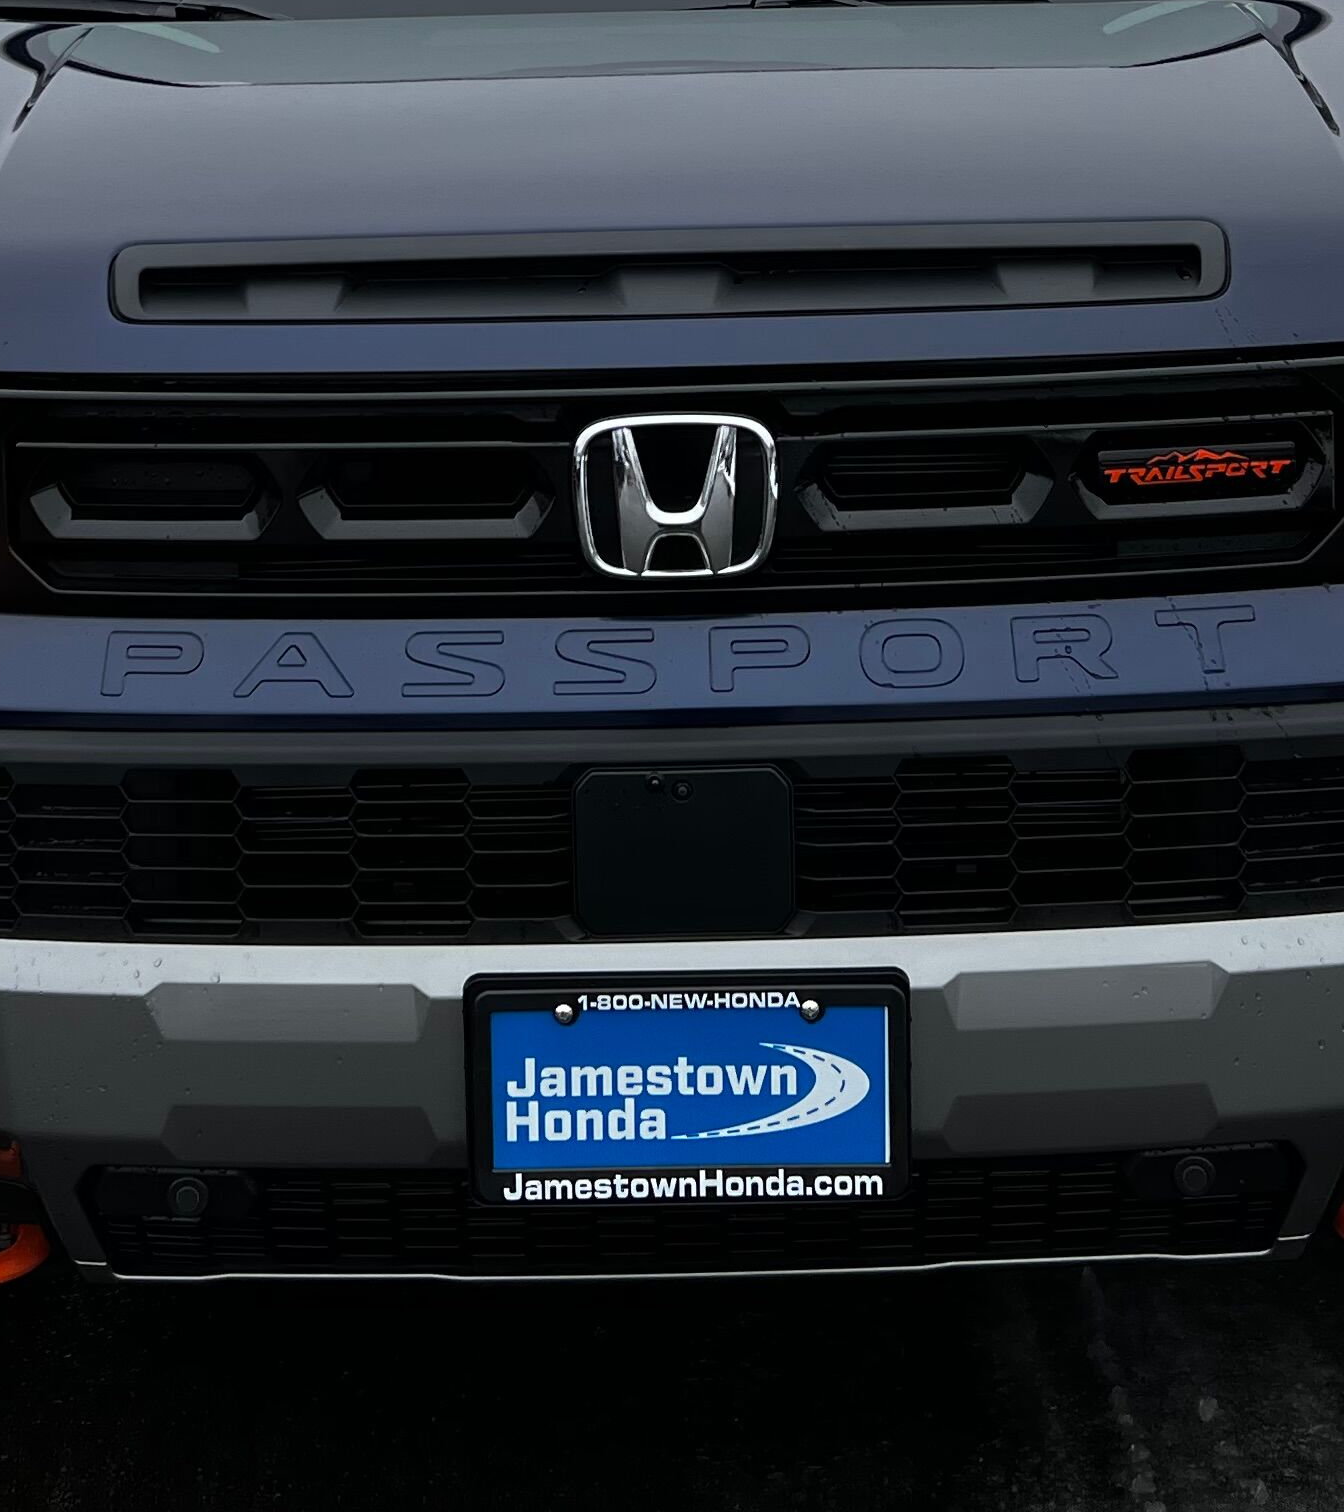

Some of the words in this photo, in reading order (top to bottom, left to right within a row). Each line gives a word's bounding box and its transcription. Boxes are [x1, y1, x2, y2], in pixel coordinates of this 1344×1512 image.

[1104, 460, 1293, 485] TRAILSPORT
[101, 604, 1255, 697] PASSPORT
[577, 991, 801, 1011] 1-800-NEW-HONDA
[506, 1056, 798, 1098] Jamestown
[506, 1098, 666, 1142] Honda
[503, 1168, 884, 1201] JamestownHonda.com
